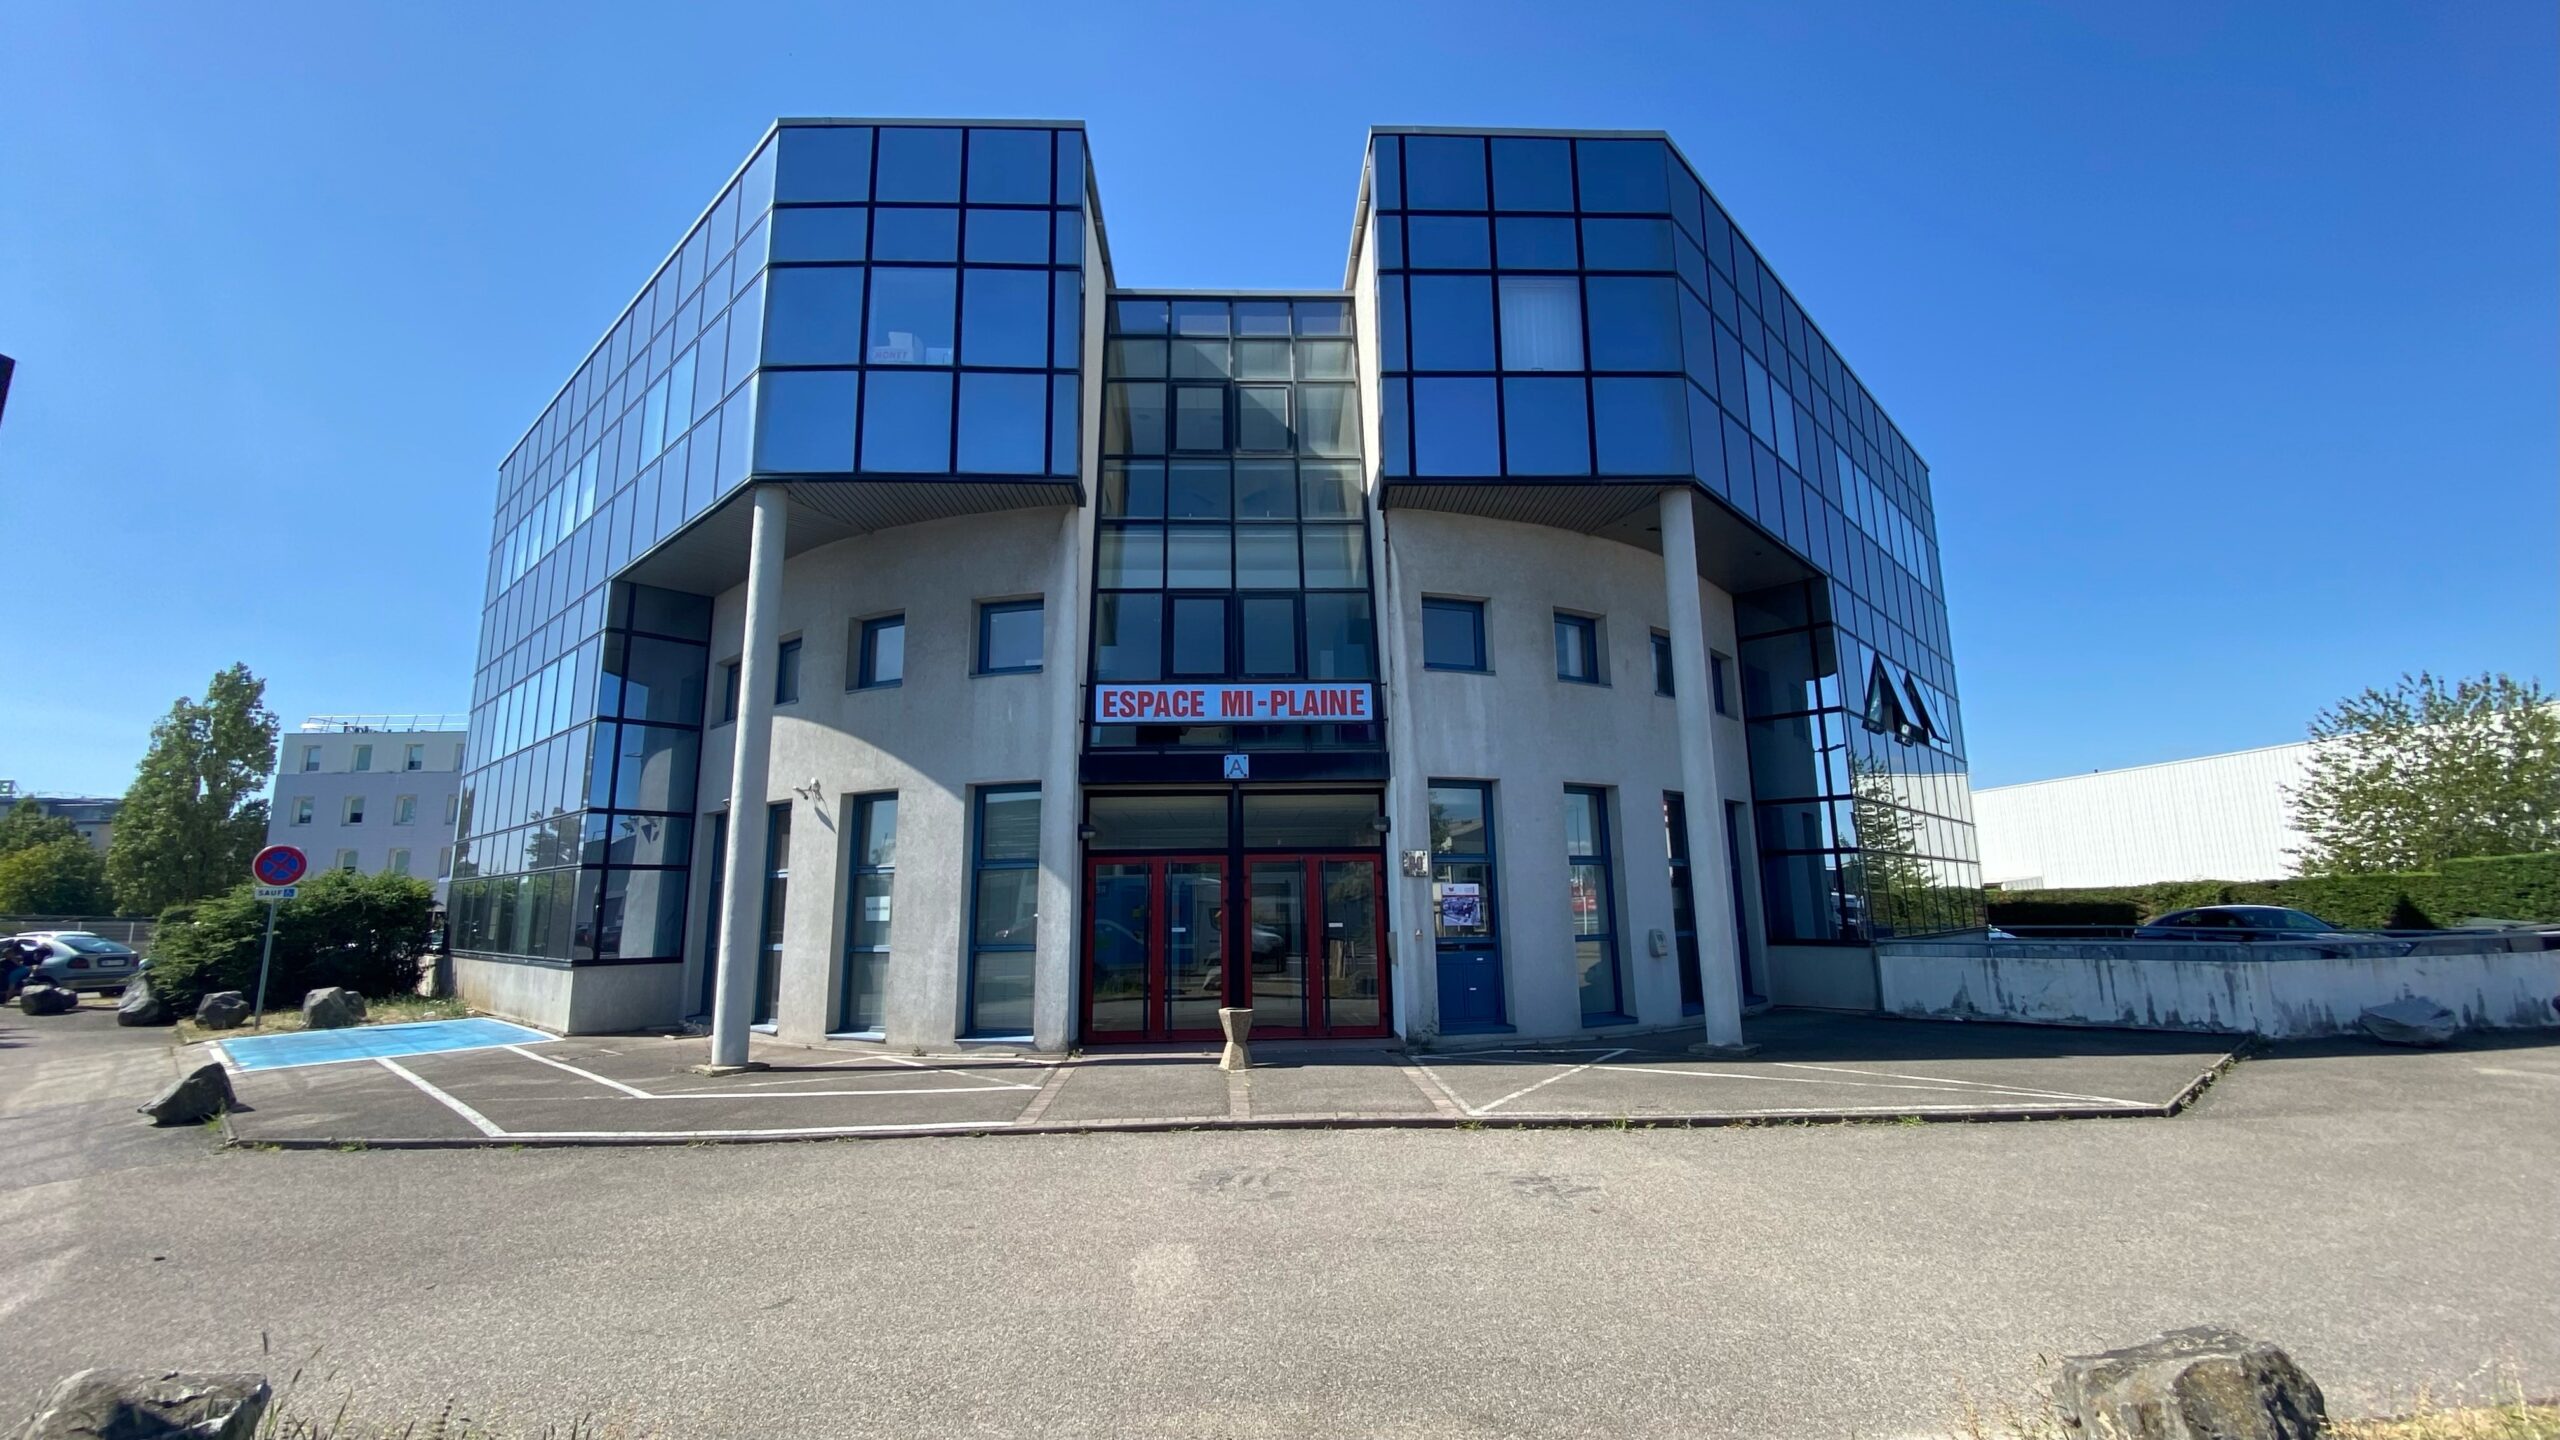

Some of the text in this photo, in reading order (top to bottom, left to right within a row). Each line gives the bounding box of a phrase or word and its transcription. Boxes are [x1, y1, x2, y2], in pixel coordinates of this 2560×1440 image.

[1103, 689, 1365, 718] ESPACE MI-PLAINE
[1229, 759, 1244, 775] A
